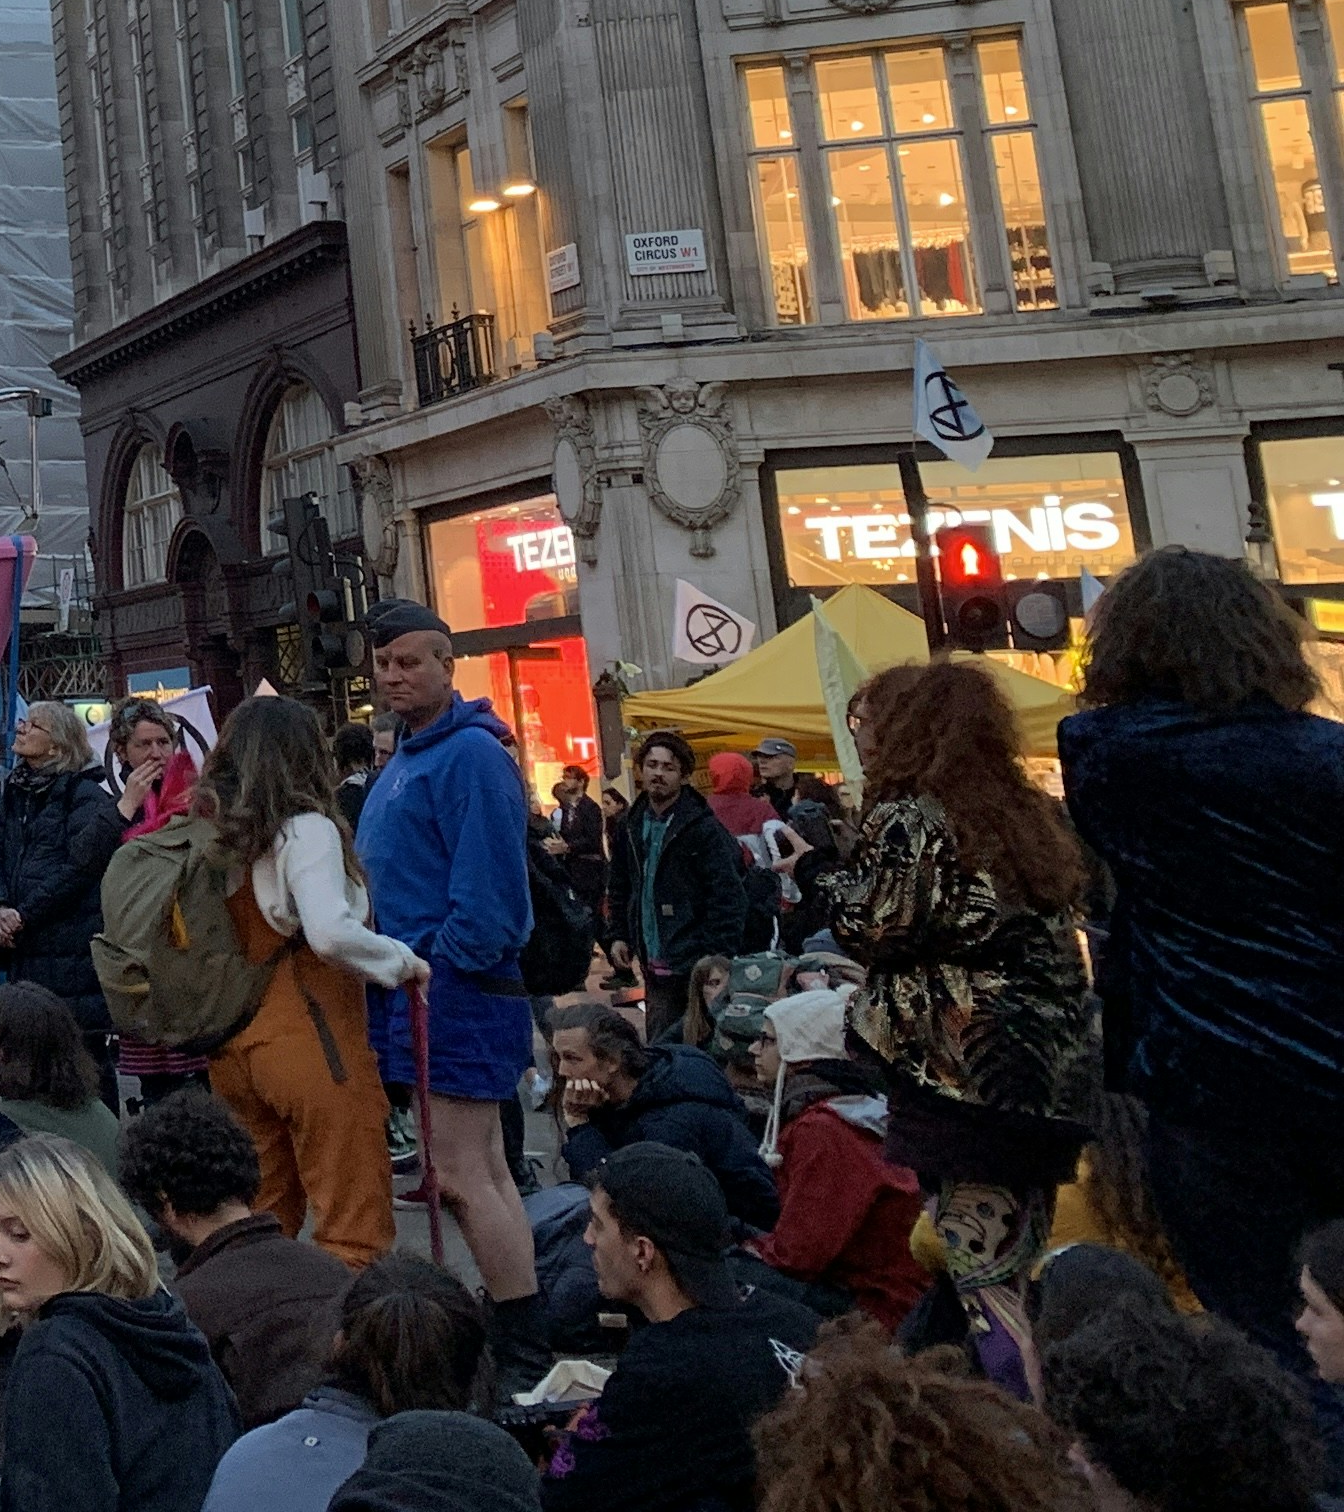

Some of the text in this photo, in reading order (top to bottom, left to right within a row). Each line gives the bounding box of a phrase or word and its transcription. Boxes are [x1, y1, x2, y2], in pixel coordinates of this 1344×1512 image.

[633, 235, 679, 248] OXFORD
[634, 247, 698, 261] CIRCUS W1
[804, 495, 1120, 560] TEZNIS
